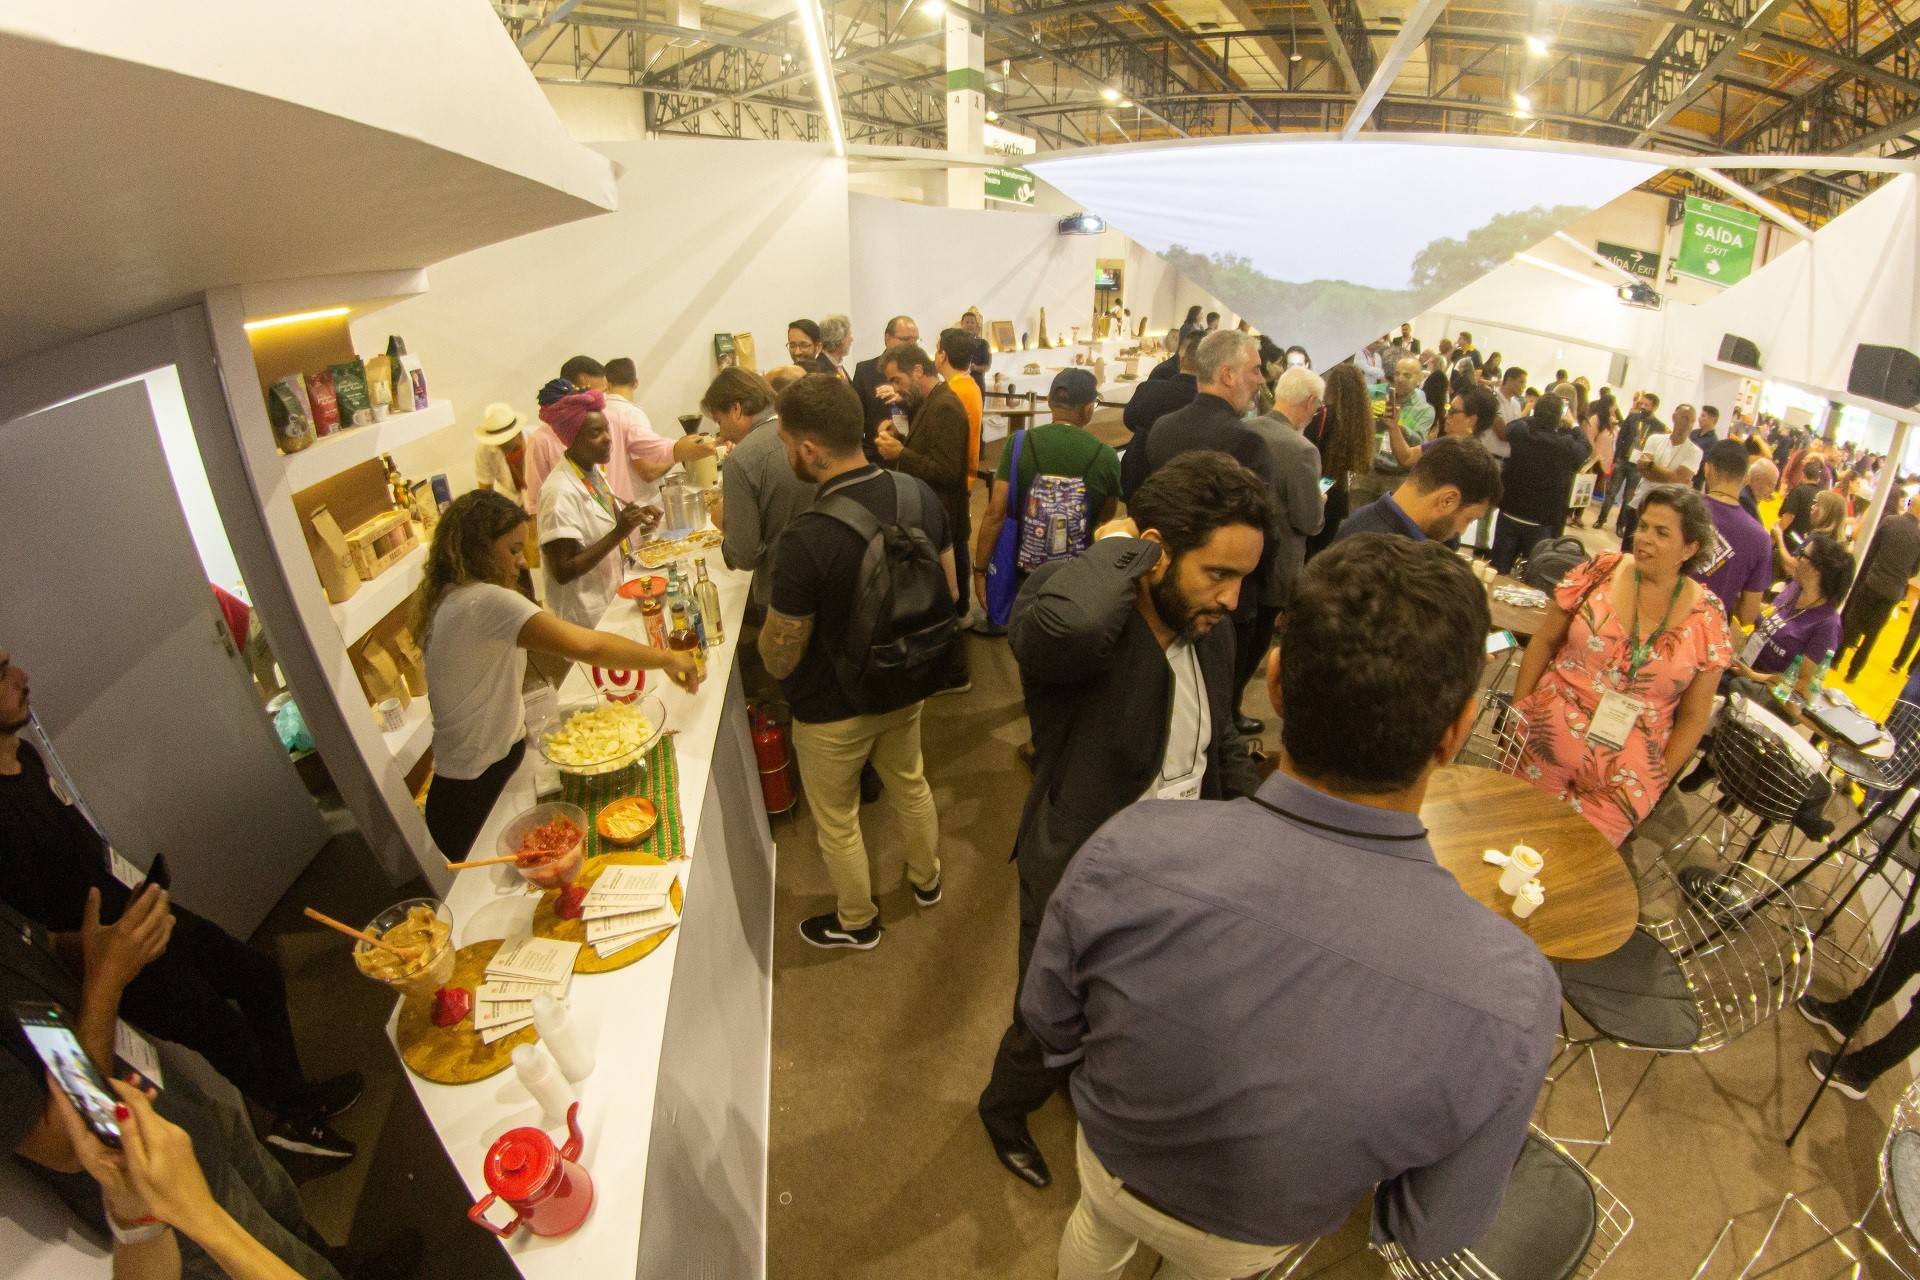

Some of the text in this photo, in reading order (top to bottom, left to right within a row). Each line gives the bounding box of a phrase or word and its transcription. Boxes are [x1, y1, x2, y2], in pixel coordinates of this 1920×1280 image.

[1003, 143, 1024, 156] wtm
[1694, 223, 1744, 249] SAÍDA
[1703, 244, 1729, 257] EXIT
[1605, 254, 1630, 271] AÍDA
[1637, 264, 1656, 276] EXIT
